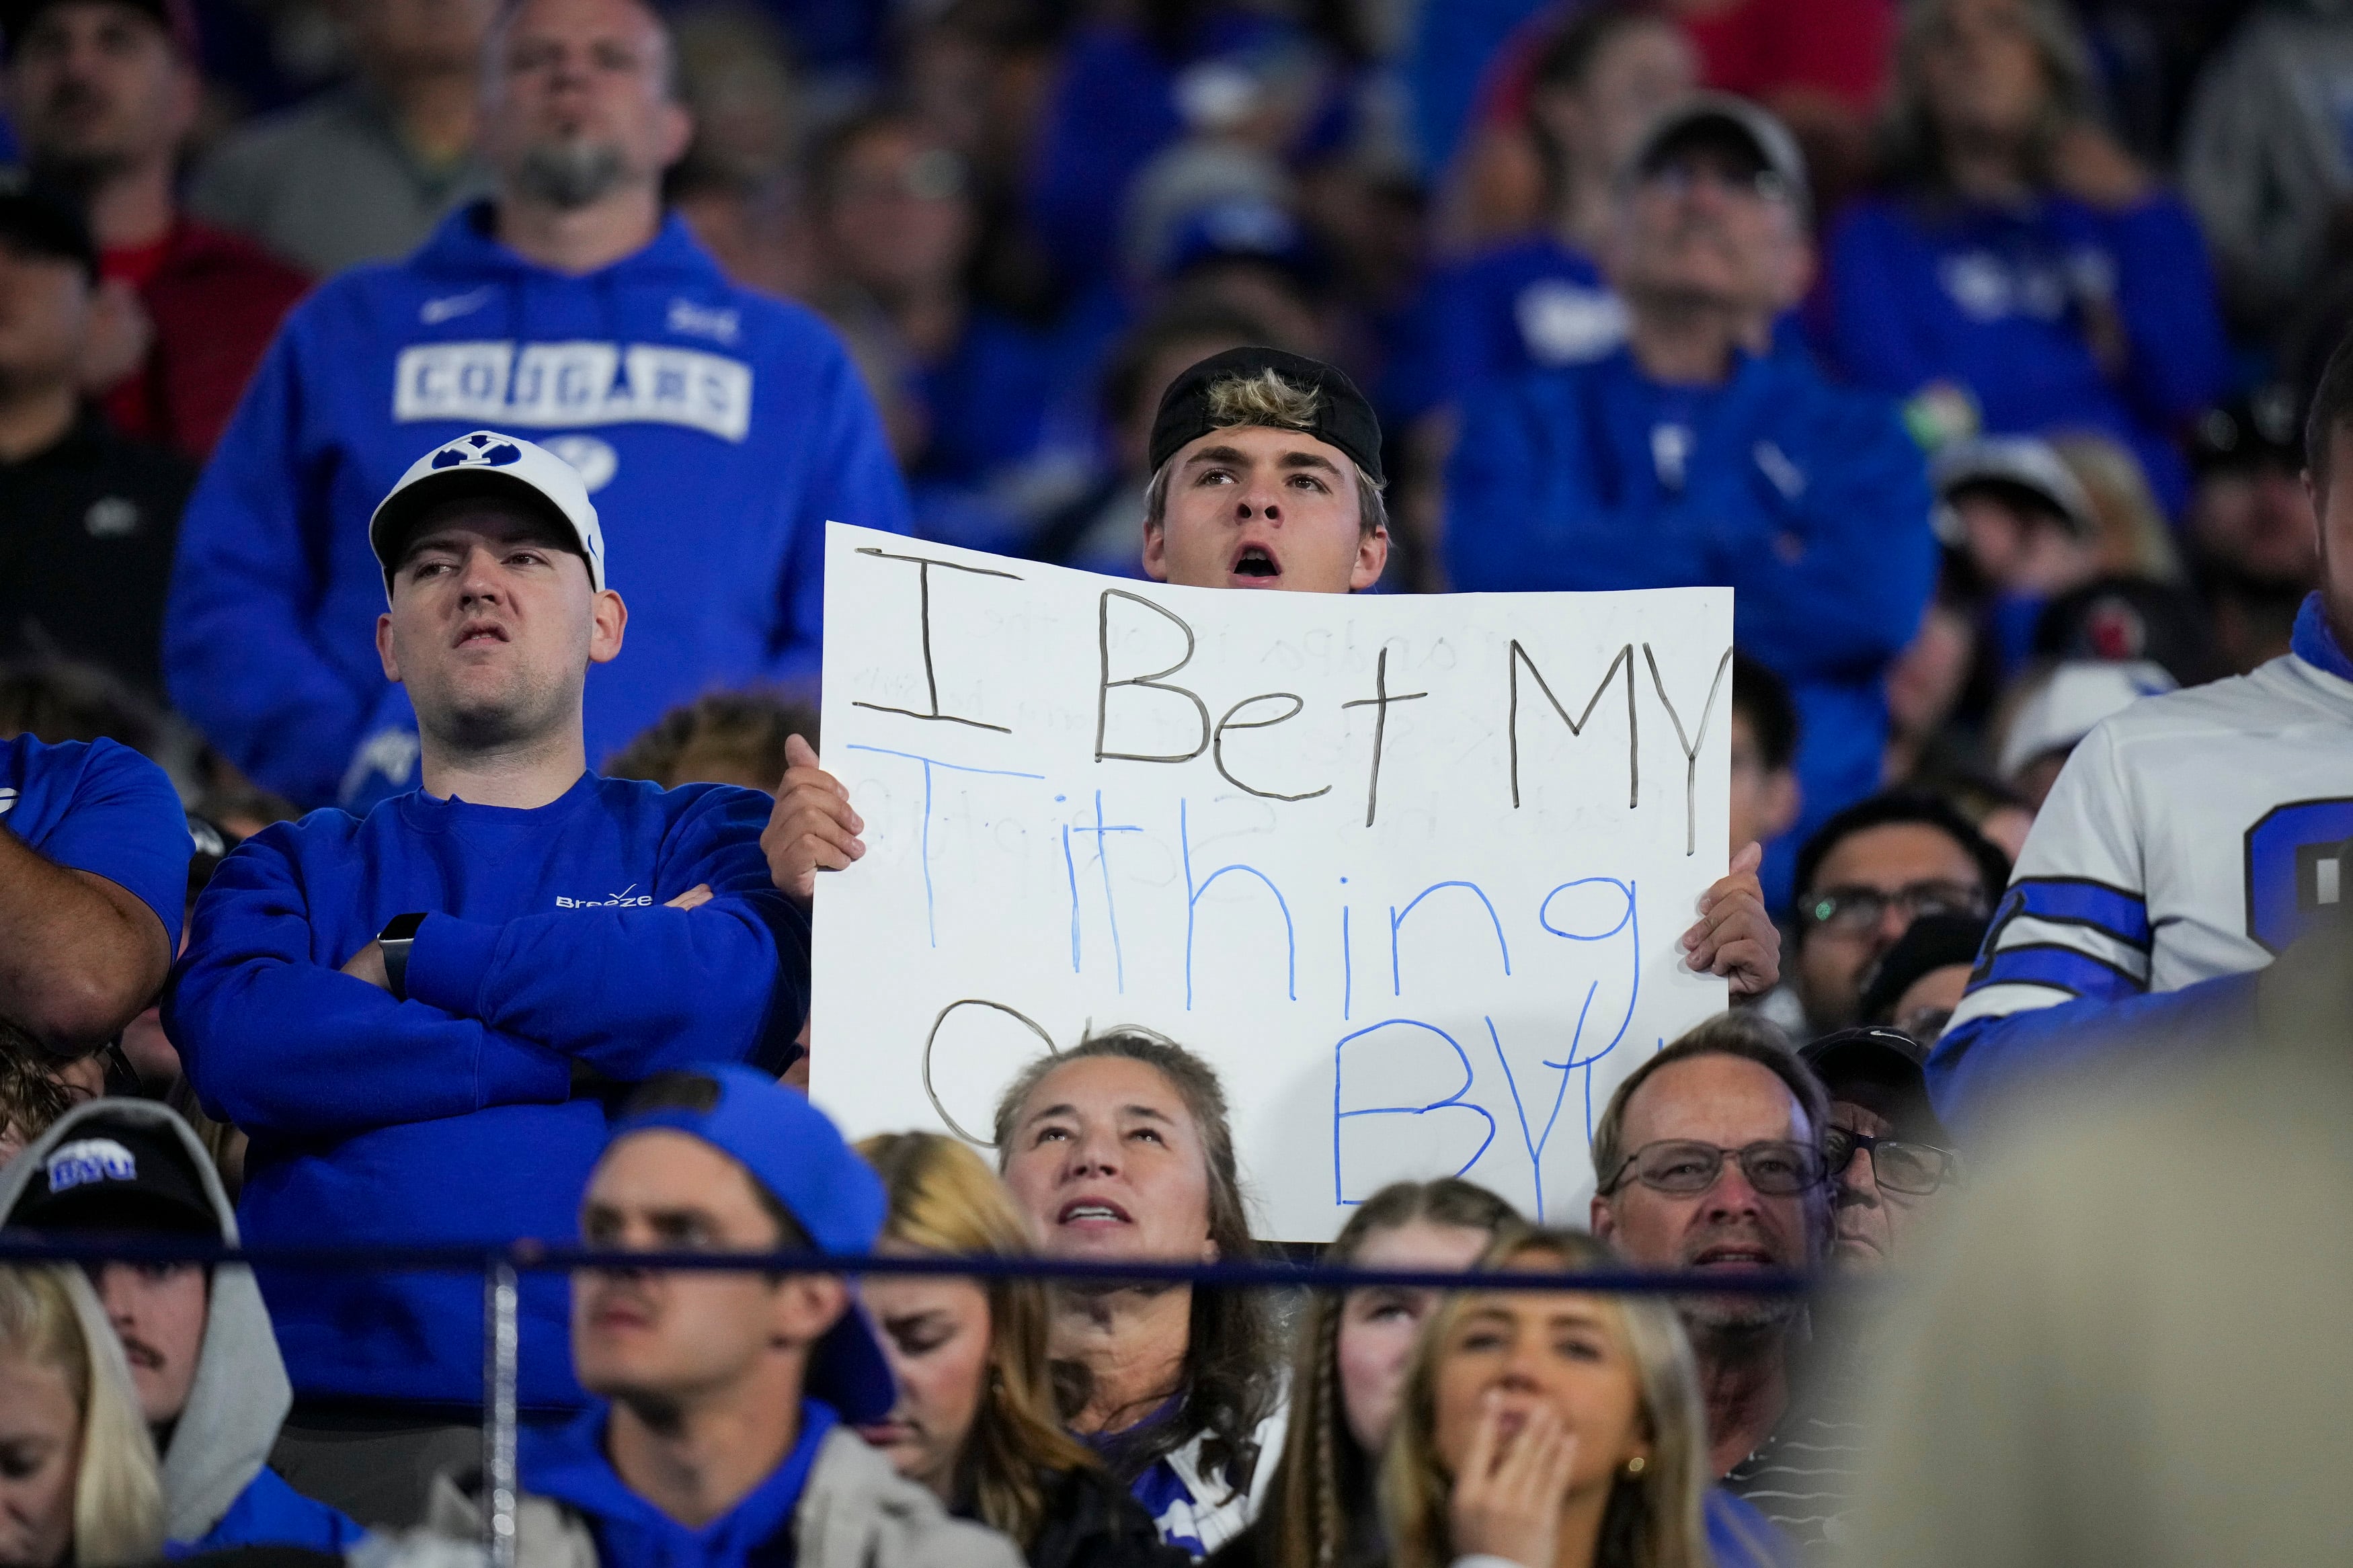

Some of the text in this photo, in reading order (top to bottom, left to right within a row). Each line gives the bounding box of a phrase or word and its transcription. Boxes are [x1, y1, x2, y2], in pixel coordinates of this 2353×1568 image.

[854, 546, 1026, 735] I
[1094, 587, 1429, 829] Bet
[847, 743, 1641, 1070] Tithing
[1334, 979, 1665, 1225] BY
